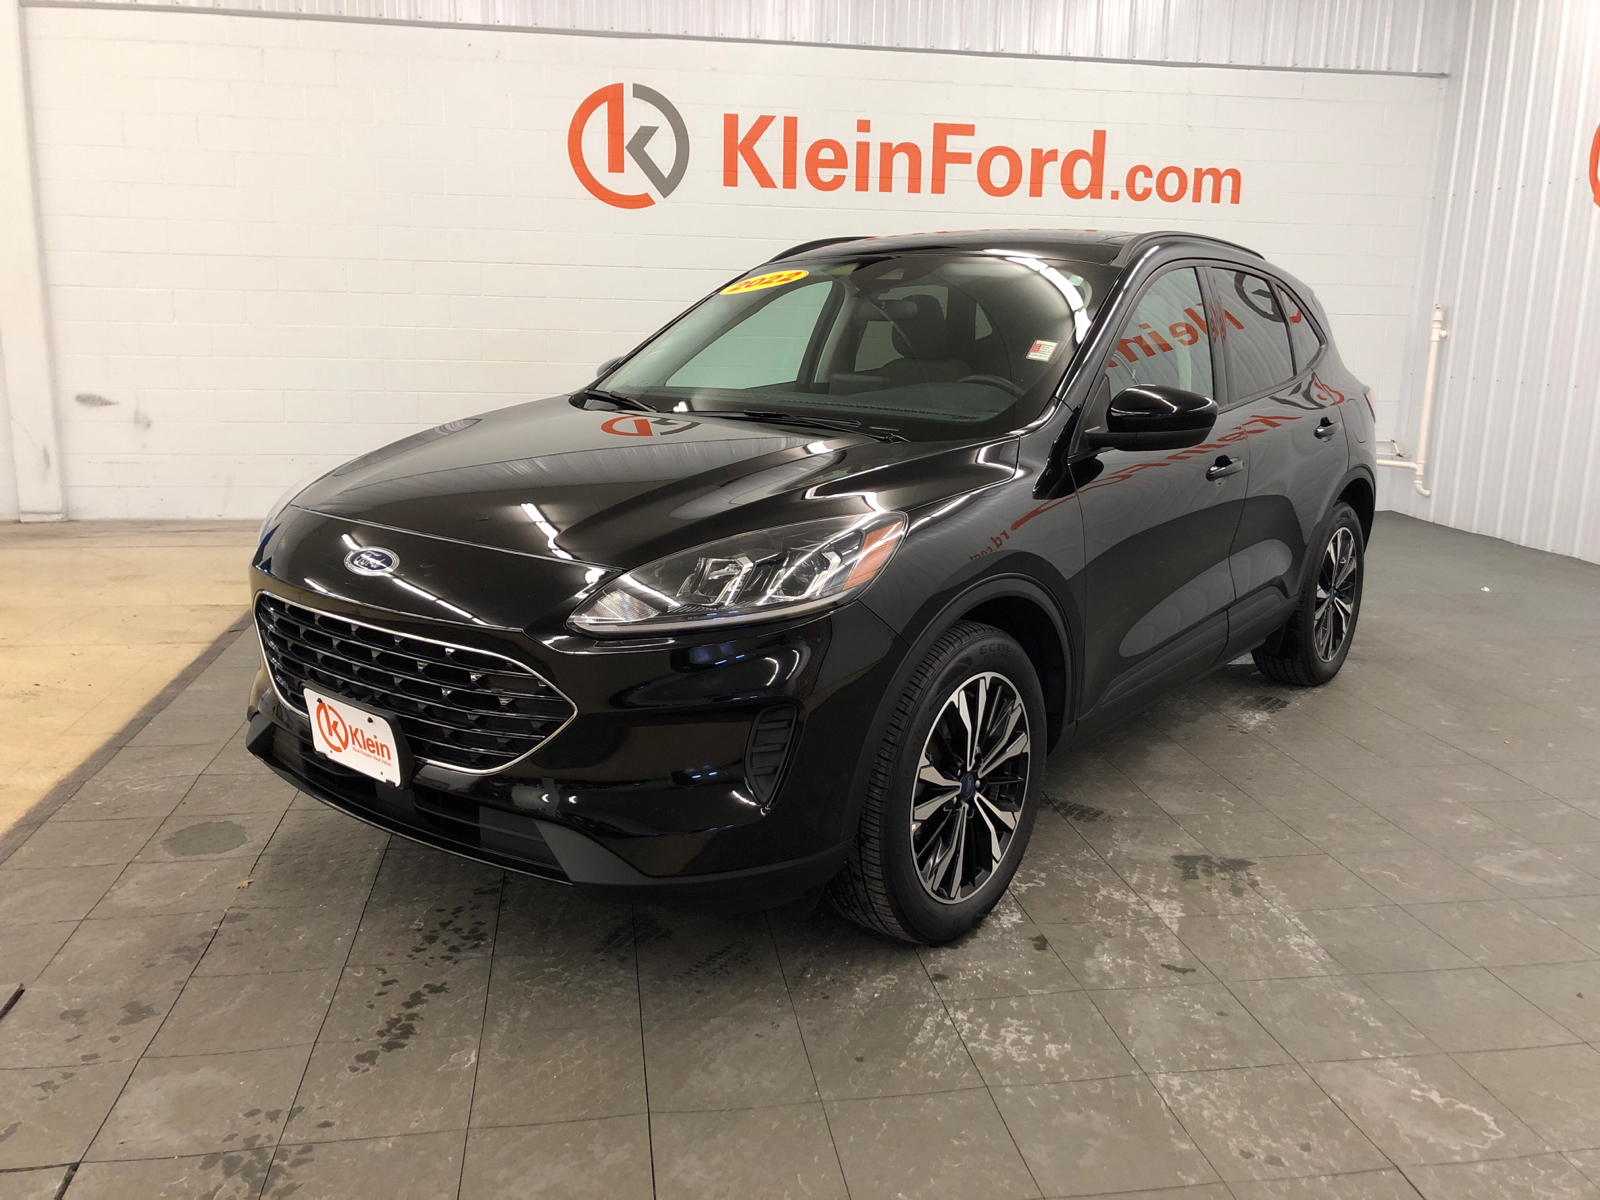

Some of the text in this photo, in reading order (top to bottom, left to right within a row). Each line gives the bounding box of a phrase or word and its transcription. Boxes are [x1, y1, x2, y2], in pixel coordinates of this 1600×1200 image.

[723, 113, 1243, 206] KleinFord.com
[728, 272, 803, 292] 2022
[349, 724, 392, 761] Klein
